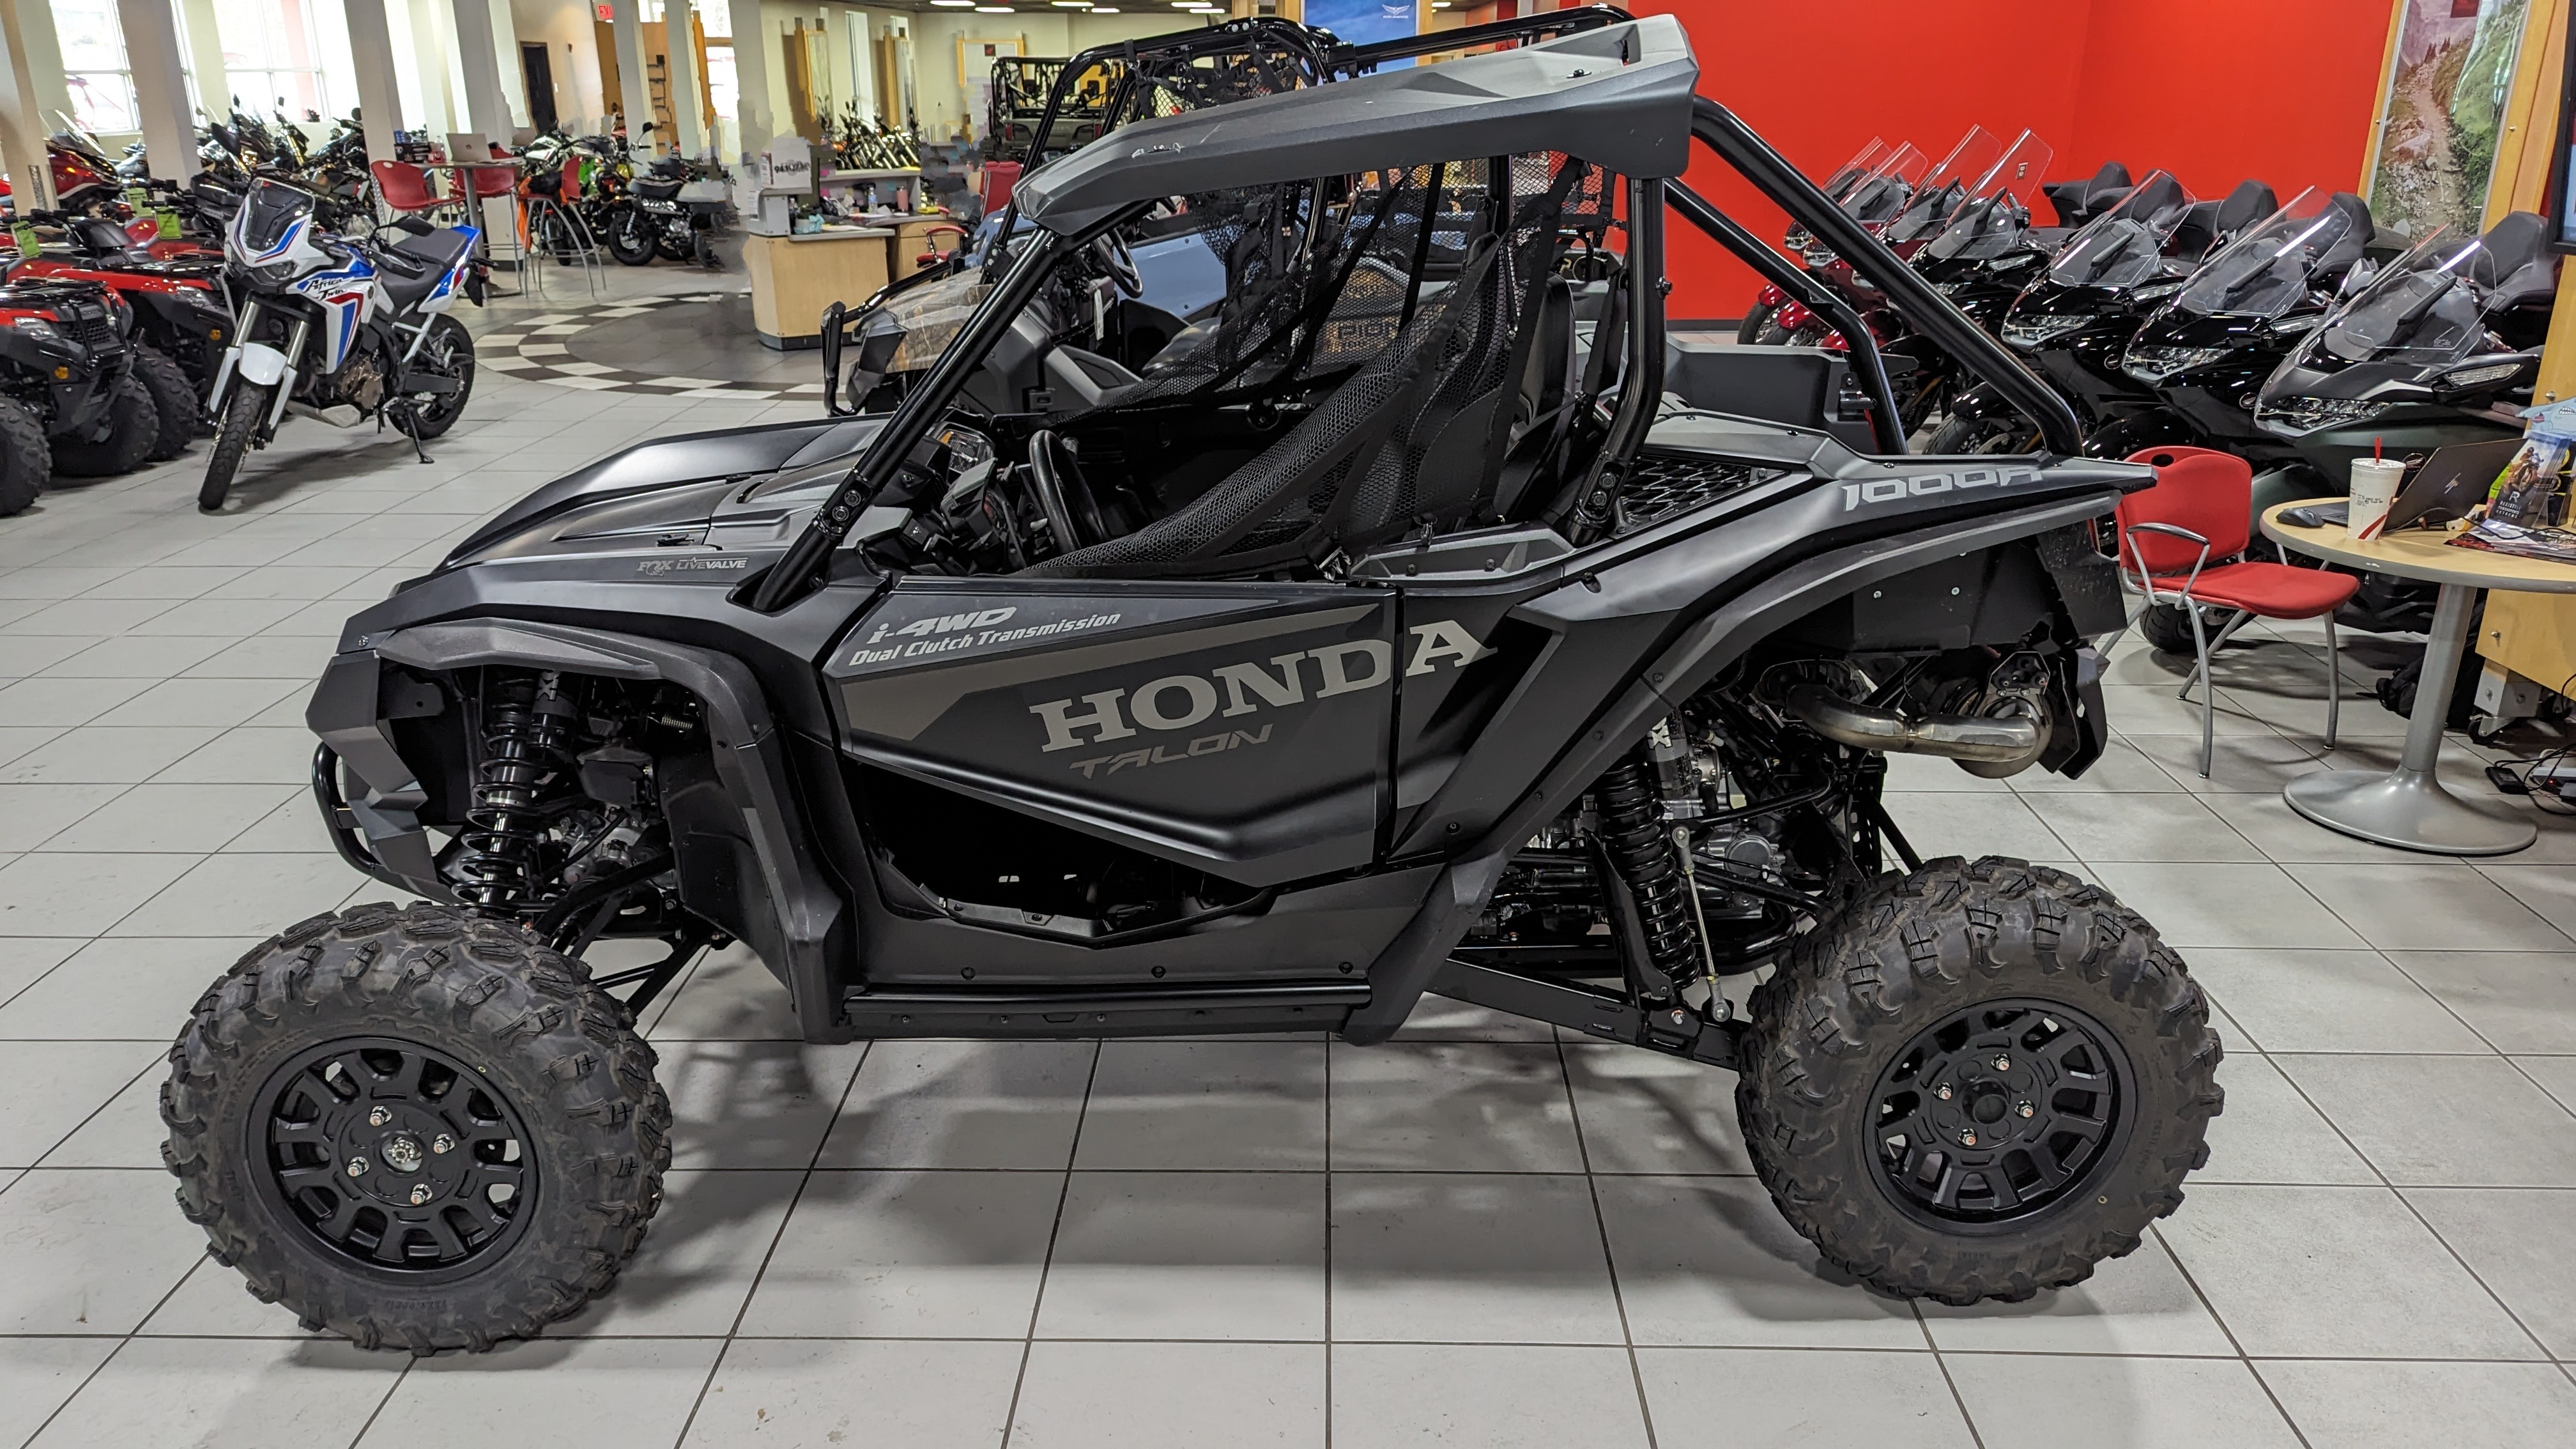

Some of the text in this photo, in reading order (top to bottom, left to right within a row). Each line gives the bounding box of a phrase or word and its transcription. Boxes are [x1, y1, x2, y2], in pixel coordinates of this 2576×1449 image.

[303, 279, 350, 293] Africa
[319, 286, 348, 301] Twin
[1338, 321, 1399, 339] PION
[1842, 466, 2043, 512] 1000R
[637, 560, 674, 576] FOX
[848, 613, 1122, 666] Dual Clutch Transmission
[867, 606, 1017, 645] i-4WD
[1029, 619, 1498, 753] HONDA
[1069, 724, 1274, 780] TALON
